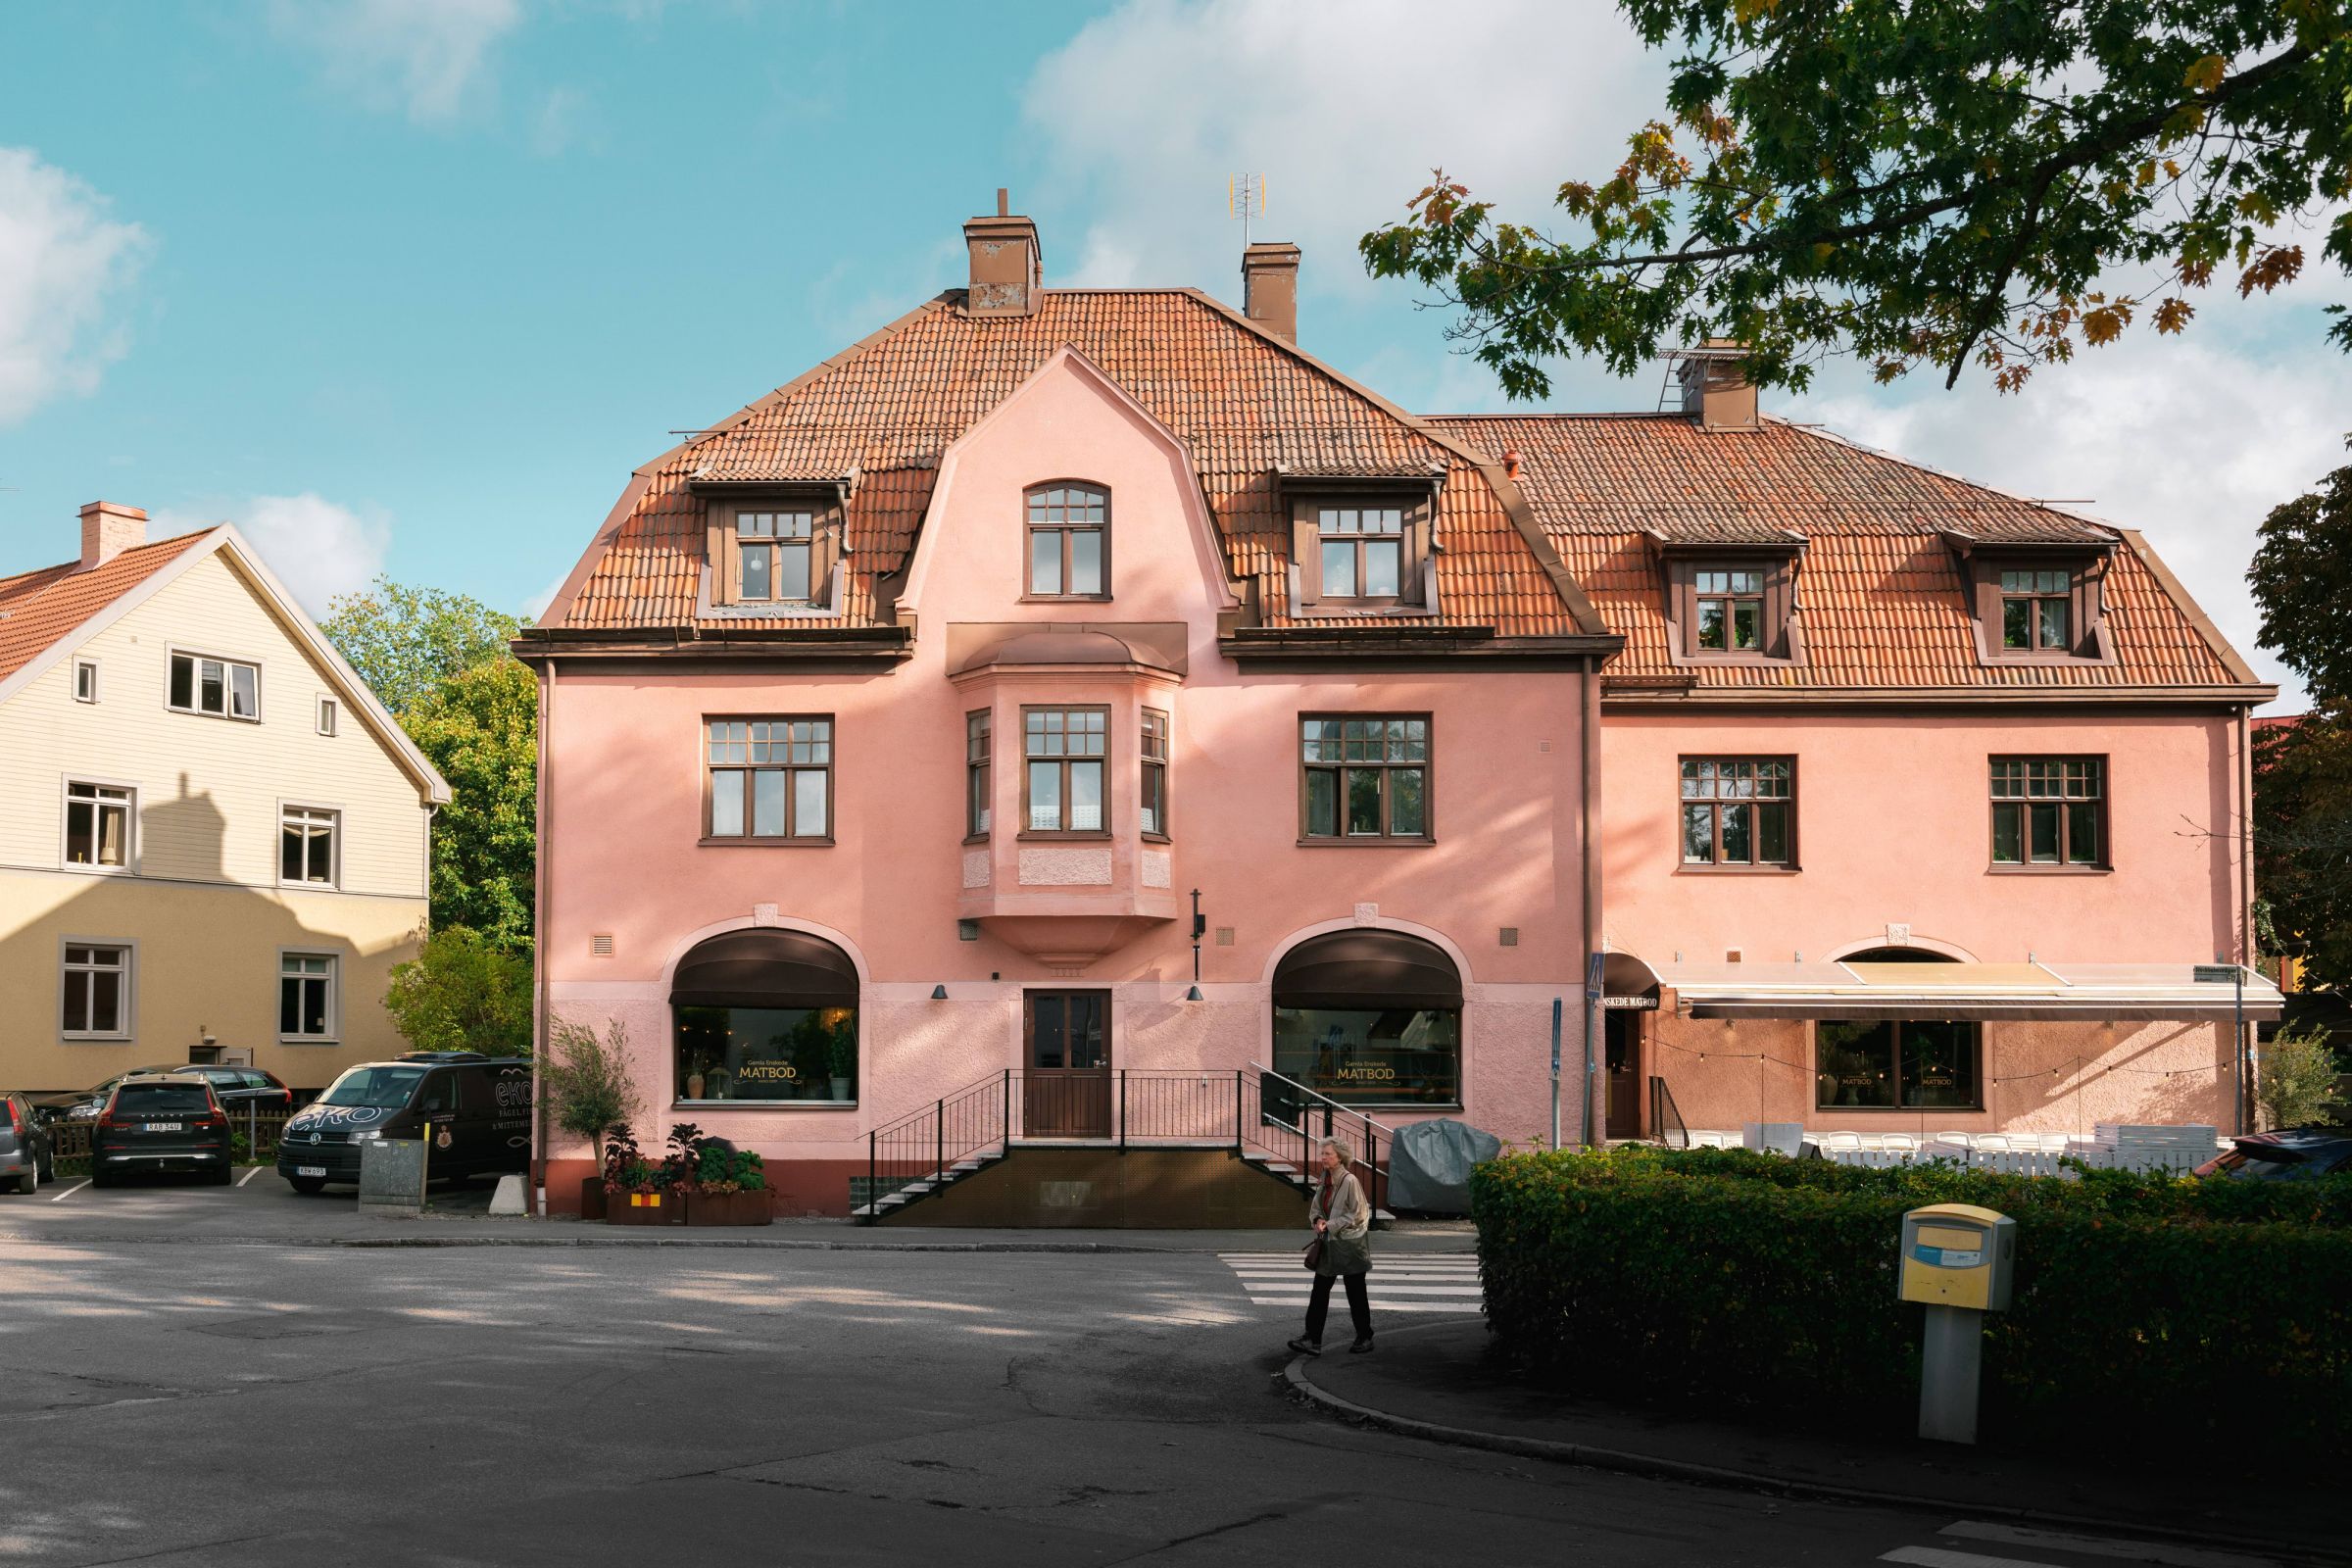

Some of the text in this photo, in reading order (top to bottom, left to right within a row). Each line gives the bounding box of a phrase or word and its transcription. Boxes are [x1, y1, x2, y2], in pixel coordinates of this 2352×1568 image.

[1630, 997, 1657, 1007] MATBOD
[739, 1067, 796, 1078] MATBOD
[1337, 1068, 1395, 1079] MATBOD
